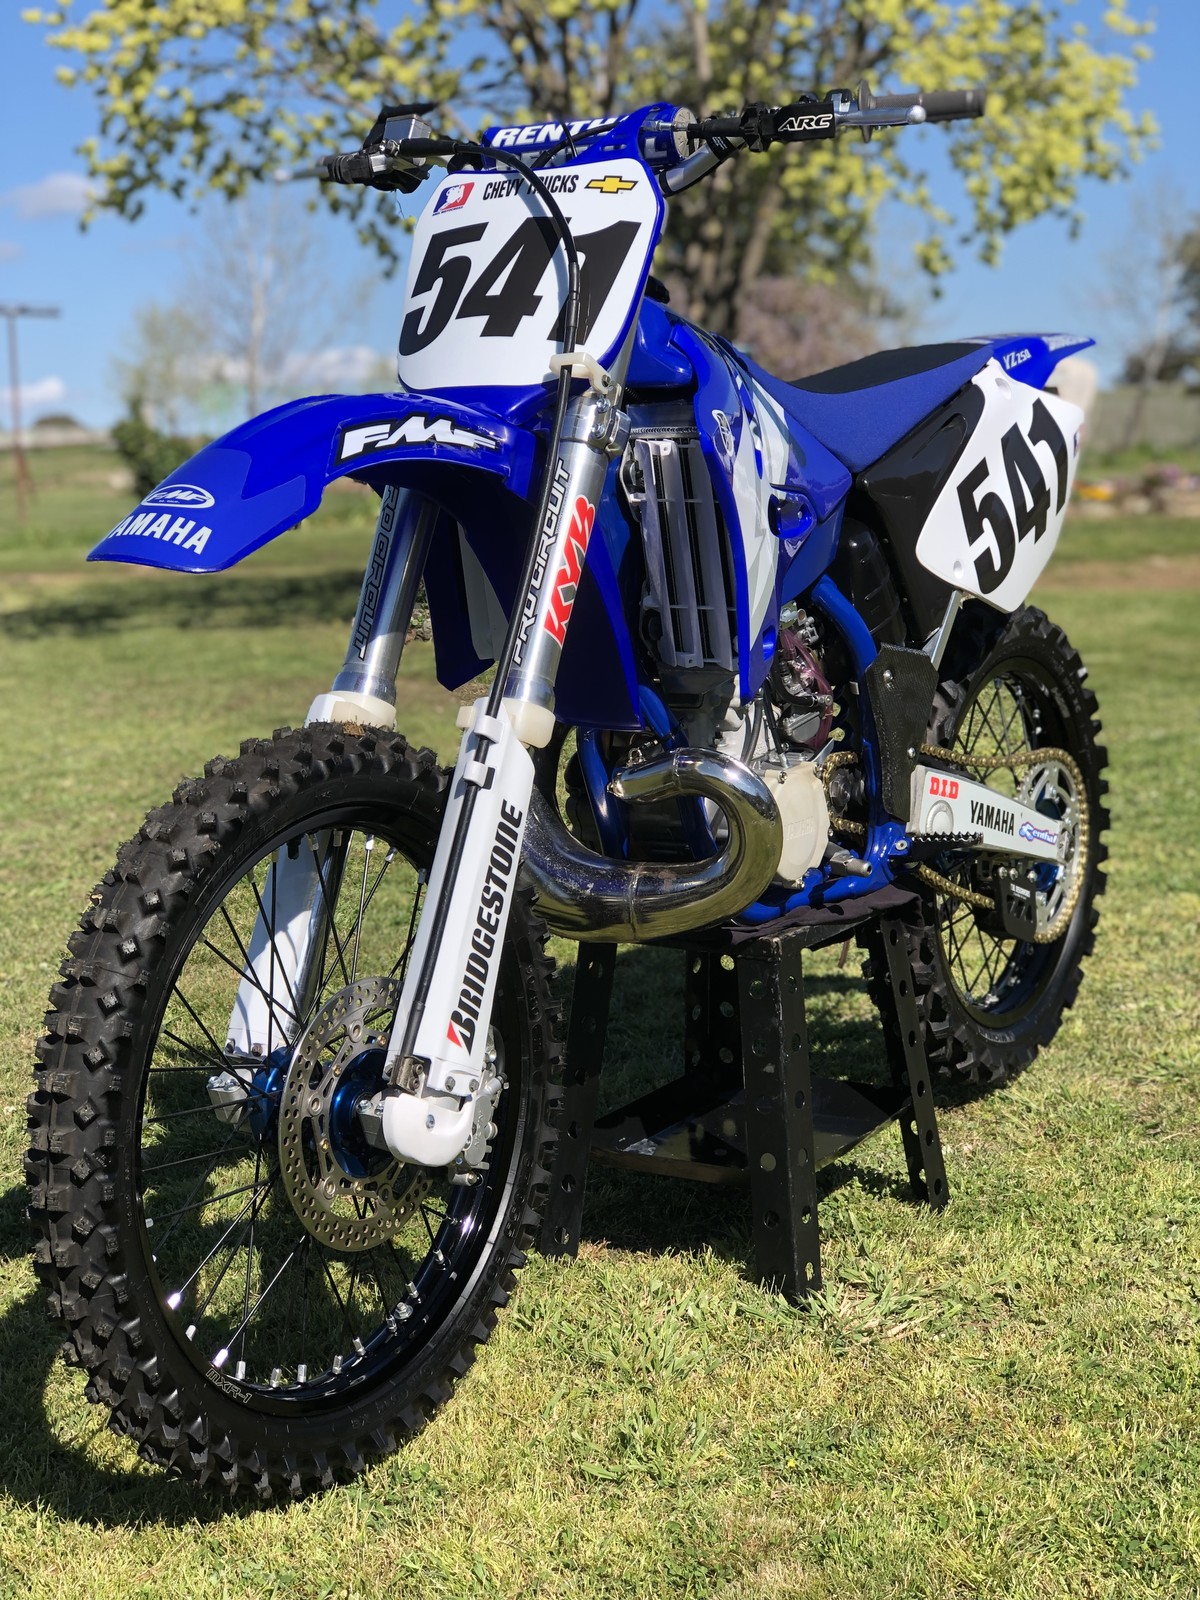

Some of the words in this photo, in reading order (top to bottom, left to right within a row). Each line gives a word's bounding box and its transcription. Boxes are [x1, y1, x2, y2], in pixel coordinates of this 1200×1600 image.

[778, 114, 833, 131] ARC
[482, 178, 525, 201] CHEVY
[399, 217, 642, 356] 541
[1003, 348, 1032, 370] YZ250
[340, 415, 497, 460] FMF
[107, 512, 213, 555] AMAHA
[956, 397, 1068, 594] 541
[354, 532, 389, 661] CIRCUIT
[512, 590, 538, 667] PRO
[529, 457, 571, 590] CIRCUIT
[543, 494, 596, 649] KYB
[970, 799, 1015, 836] YAMAHA
[446, 798, 523, 1056] BRIDGESTONE
